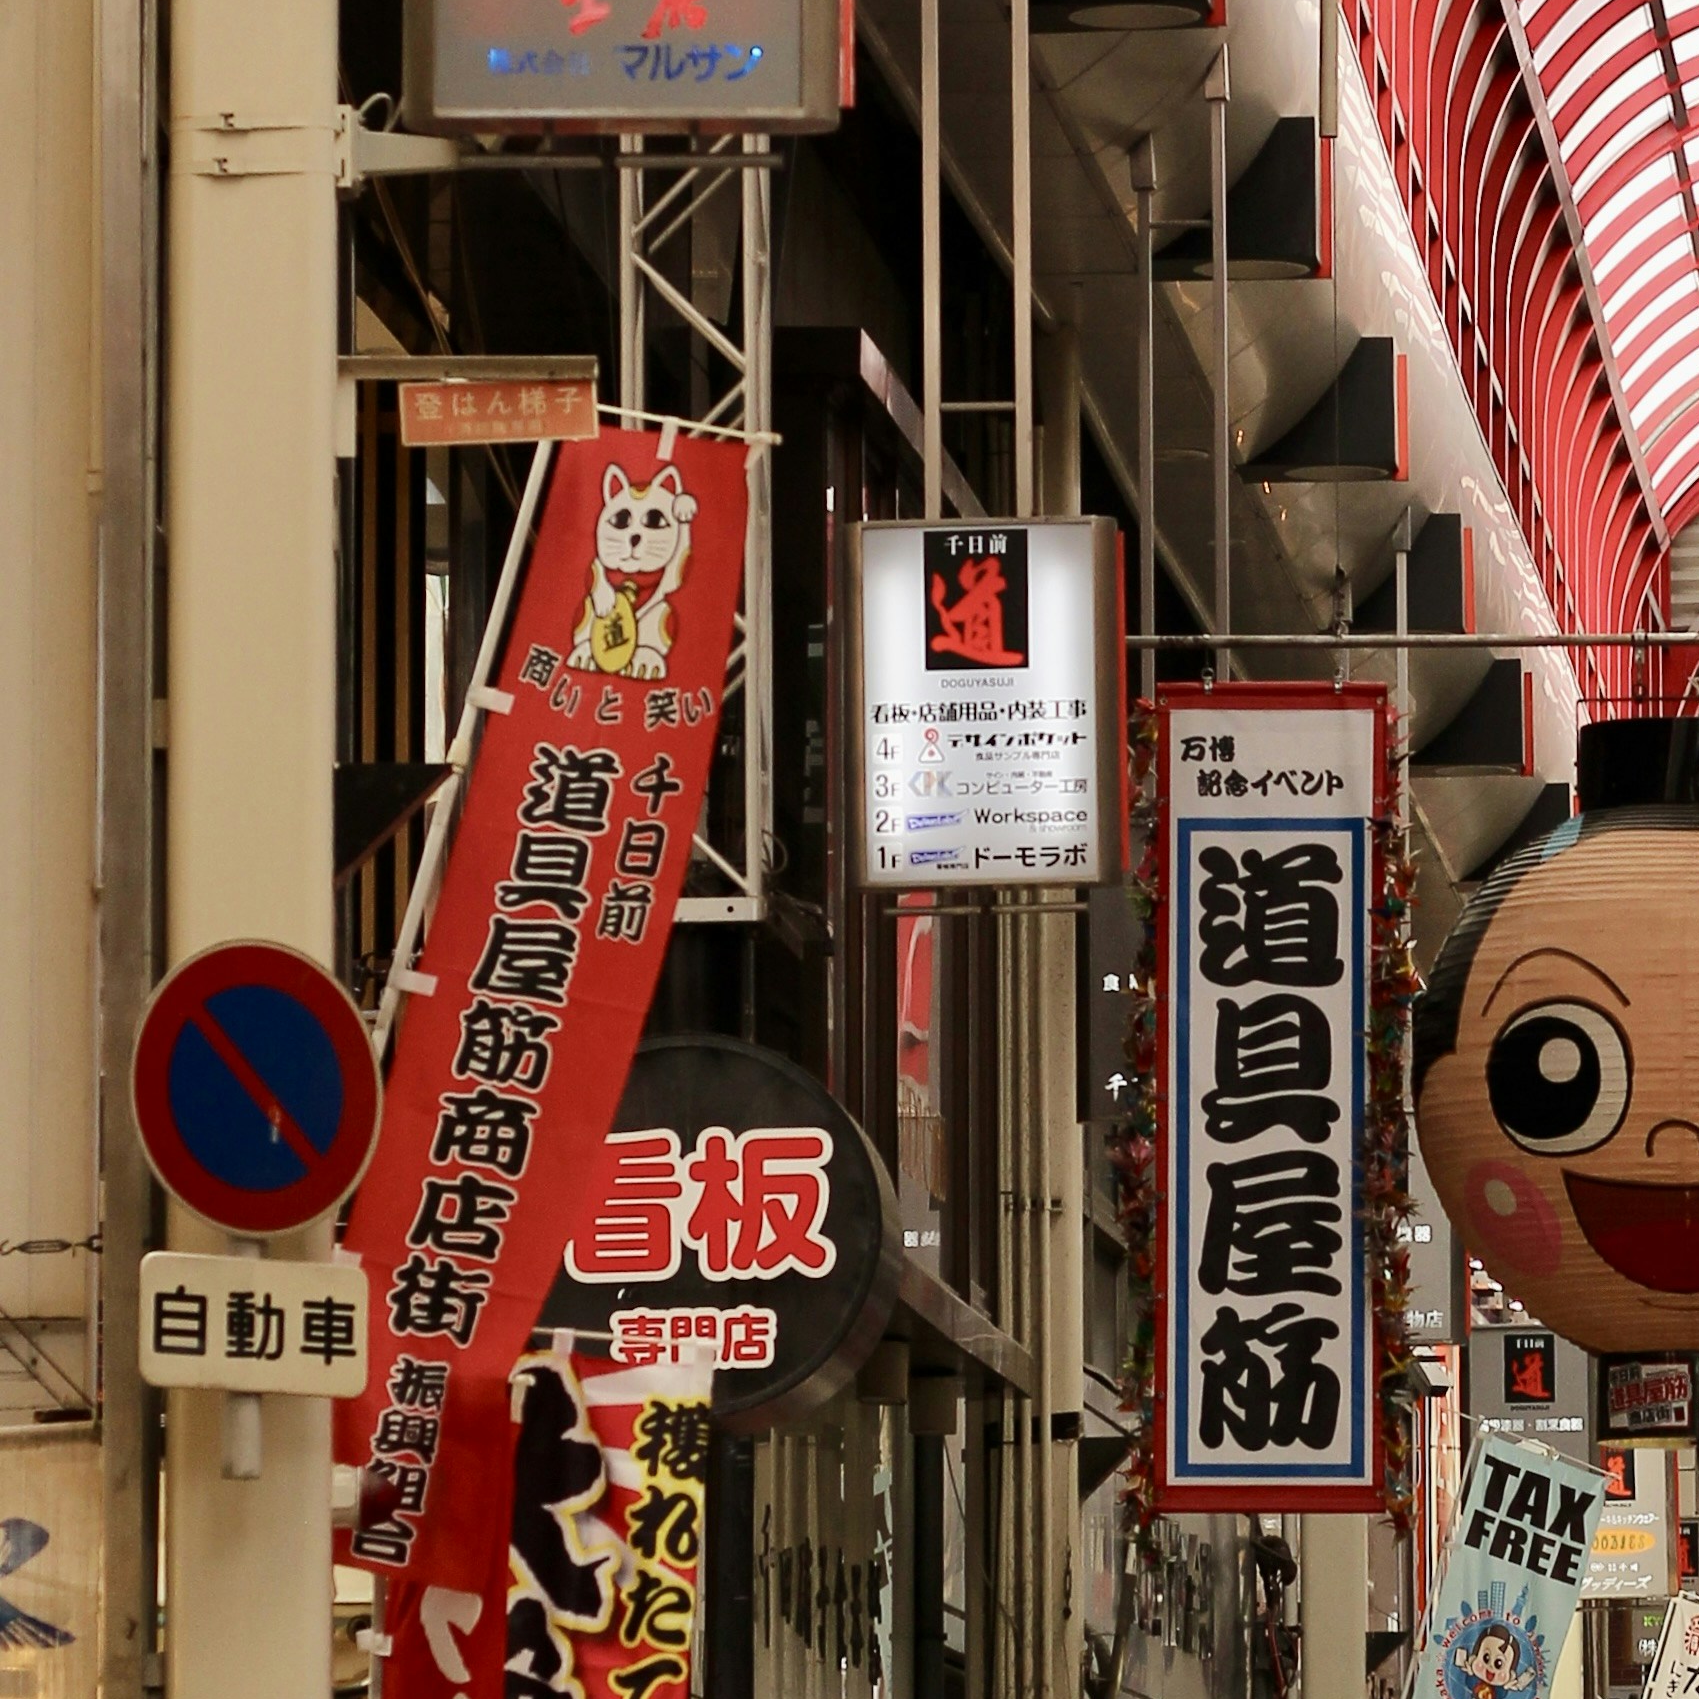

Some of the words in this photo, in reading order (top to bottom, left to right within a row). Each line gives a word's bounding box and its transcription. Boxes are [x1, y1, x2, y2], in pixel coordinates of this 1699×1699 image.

[613, 44, 765, 82] マルサン
[414, 387, 584, 422] 登はん梯子
[943, 533, 1009, 557] 千日前
[939, 676, 1016, 689] DOGUYASUJI
[869, 698, 1088, 724] 看板・店舗用品・内装工事
[875, 734, 900, 761] 4F
[1180, 735, 1236, 763] 万博
[874, 770, 900, 798] 3F
[956, 778, 1088, 797] コンピューター工房
[1197, 768, 1345, 798] 記念イベント
[875, 808, 900, 834] 2F
[974, 807, 1088, 826] Workspace
[596, 751, 685, 943] 千日前
[877, 845, 900, 871] 1F
[973, 842, 1088, 869] ドーモラボ
[386, 741, 625, 1349] 道具屋筋商店街
[1198, 841, 1345, 1453] 道具屋筋
[564, 1127, 835, 1282] 看板
[150, 1284, 359, 1368] 自動車
[610, 1306, 777, 1369] 専門店
[1481, 1452, 1595, 1545] TAX
[1463, 1508, 1585, 1586] FREE
[1505, 1611, 1521, 1626] to
